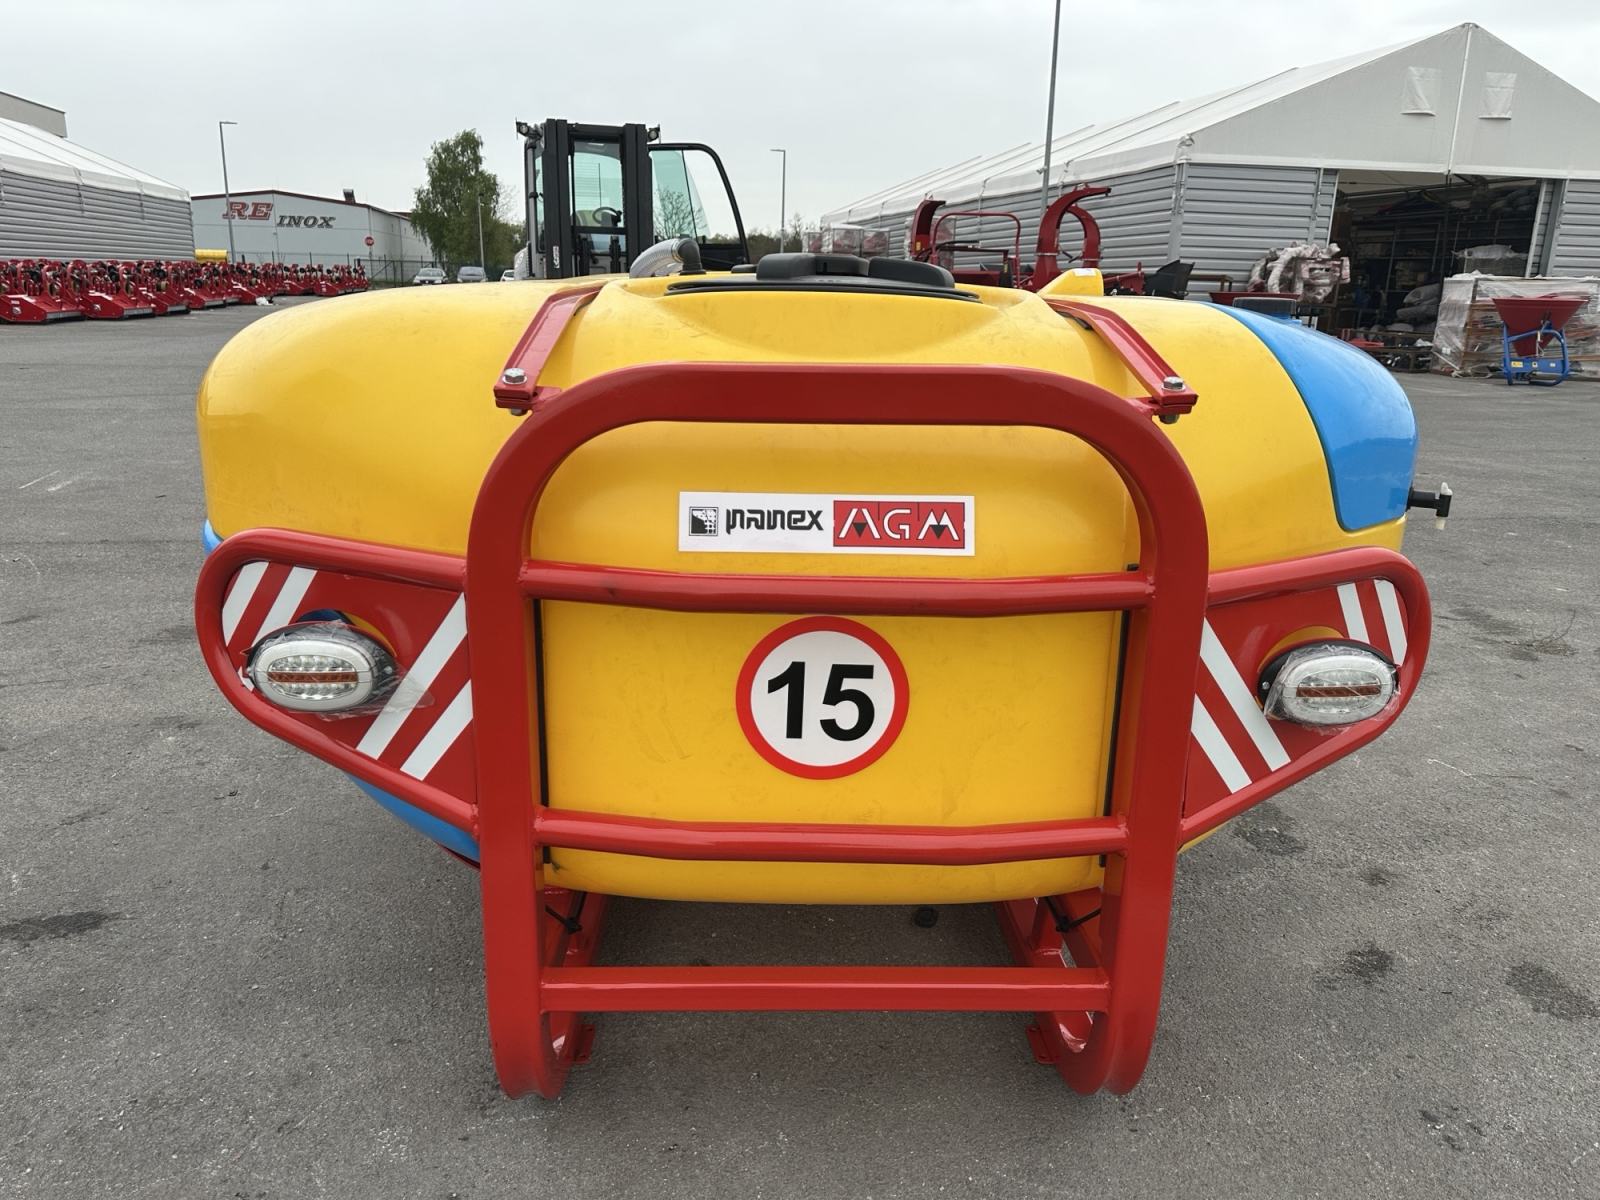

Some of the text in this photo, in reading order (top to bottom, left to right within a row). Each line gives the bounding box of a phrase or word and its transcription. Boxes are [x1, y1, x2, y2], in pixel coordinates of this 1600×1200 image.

[222, 201, 336, 229] RE INOX
[838, 507, 961, 541] AGM
[767, 661, 875, 742] 15
